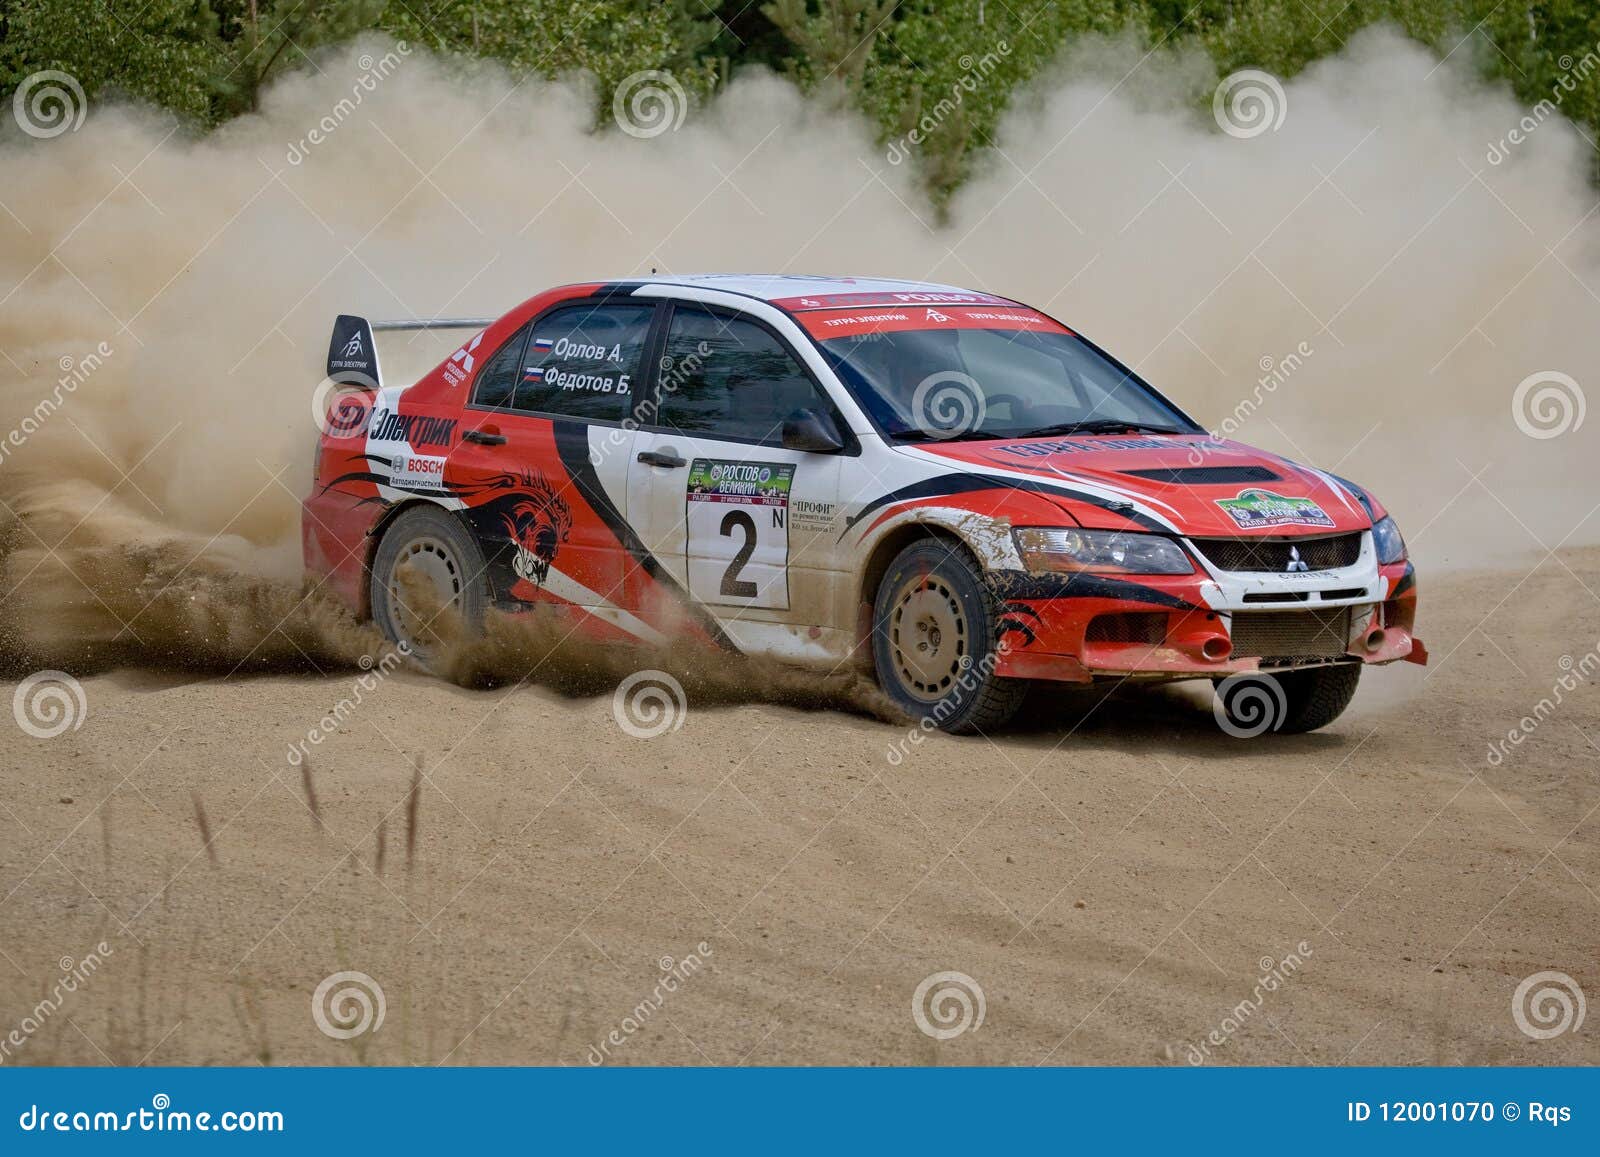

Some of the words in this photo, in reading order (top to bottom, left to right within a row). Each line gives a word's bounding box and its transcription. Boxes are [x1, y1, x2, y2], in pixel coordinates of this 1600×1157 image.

[554, 337, 605, 361] Орлов
[607, 344, 625, 363] А.
[544, 367, 613, 391] Федотов
[616, 374, 632, 395] Б.
[408, 459, 443, 473] BOSCH
[721, 464, 760, 481] РОСТОВ
[390, 476, 441, 489] Автодиагностика
[772, 508, 784, 529] N
[719, 509, 758, 598] 2
